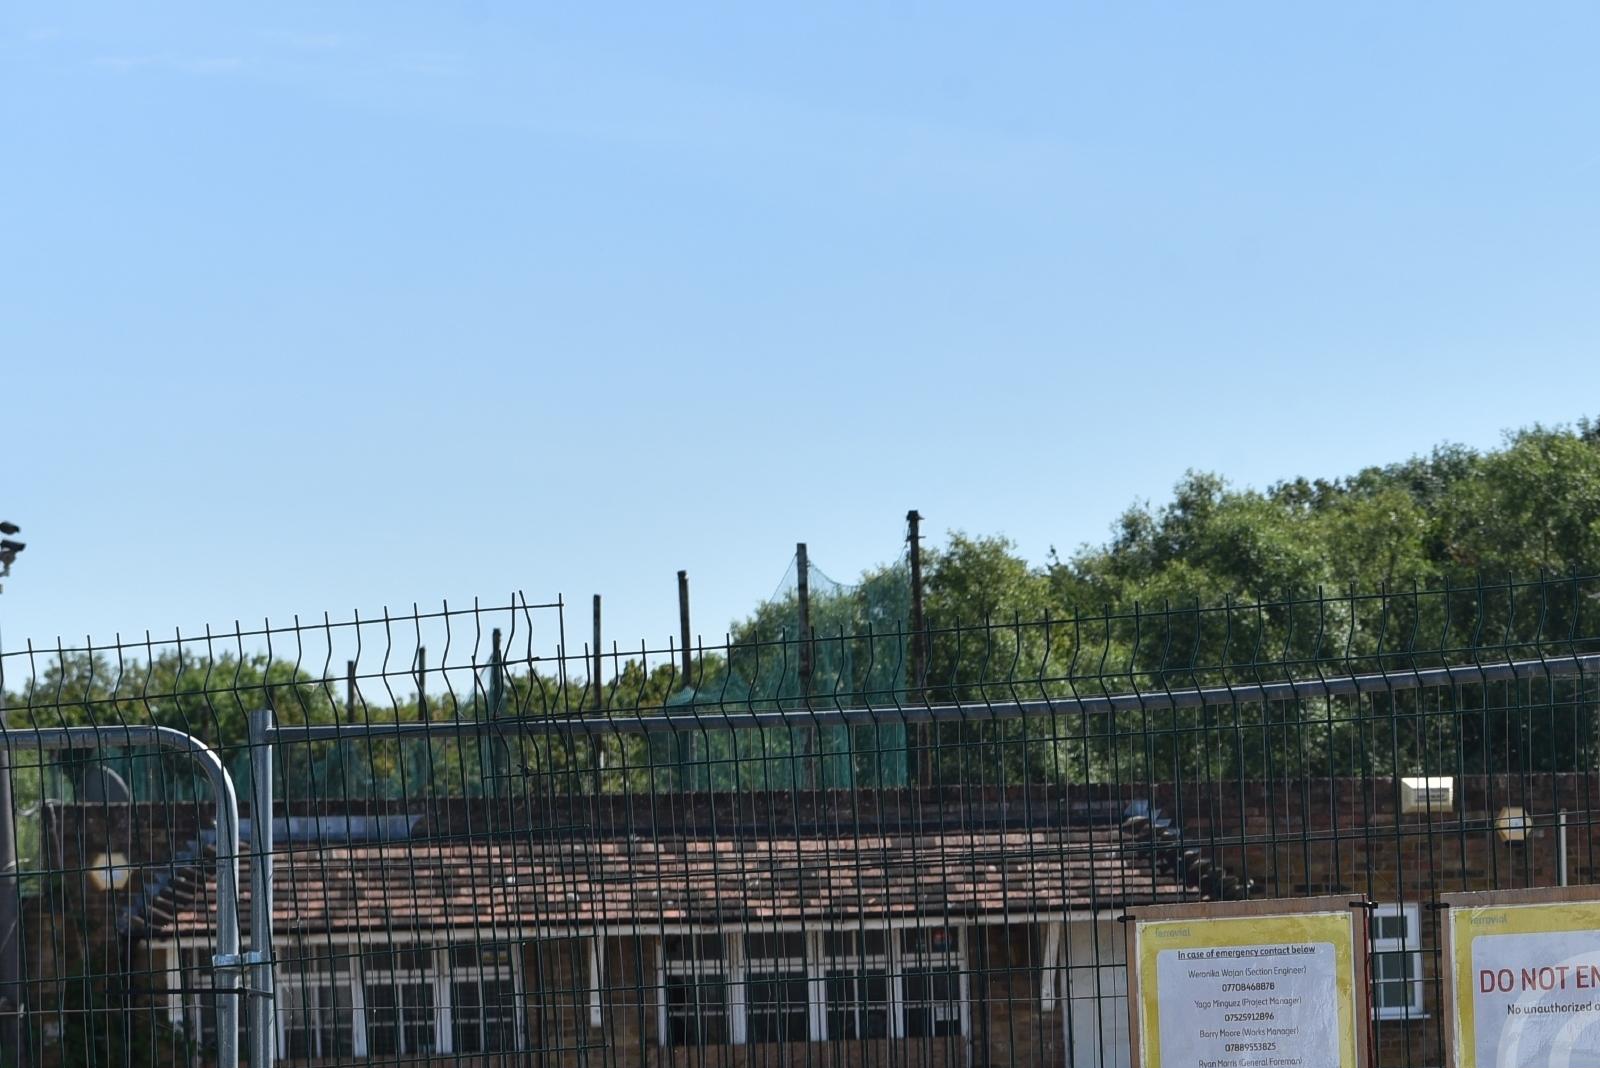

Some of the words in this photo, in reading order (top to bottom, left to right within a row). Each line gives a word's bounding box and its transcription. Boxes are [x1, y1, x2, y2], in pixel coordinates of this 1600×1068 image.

[1178, 950, 1186, 960] In
[1206, 949, 1215, 958] of
[1216, 949, 1259, 959] emergency
[1260, 947, 1290, 956] contact
[1292, 945, 1316, 955] below
[1245, 967, 1273, 977] (Section
[1274, 965, 1307, 977] Engineer)
[1480, 969, 1514, 993] DO
[1521, 966, 1569, 991] NOT
[1242, 998, 1268, 1008] (Project
[1270, 996, 1302, 1008] Manager)
[1507, 1003, 1522, 1015] No
[1523, 1001, 1592, 1015] unauthorized
[1200, 1030, 1219, 1040] Barry
[1220, 1029, 1241, 1038] Moore
[1267, 1026, 1300, 1038] Manager)
[1270, 1055, 1303, 1067] Foreman)
